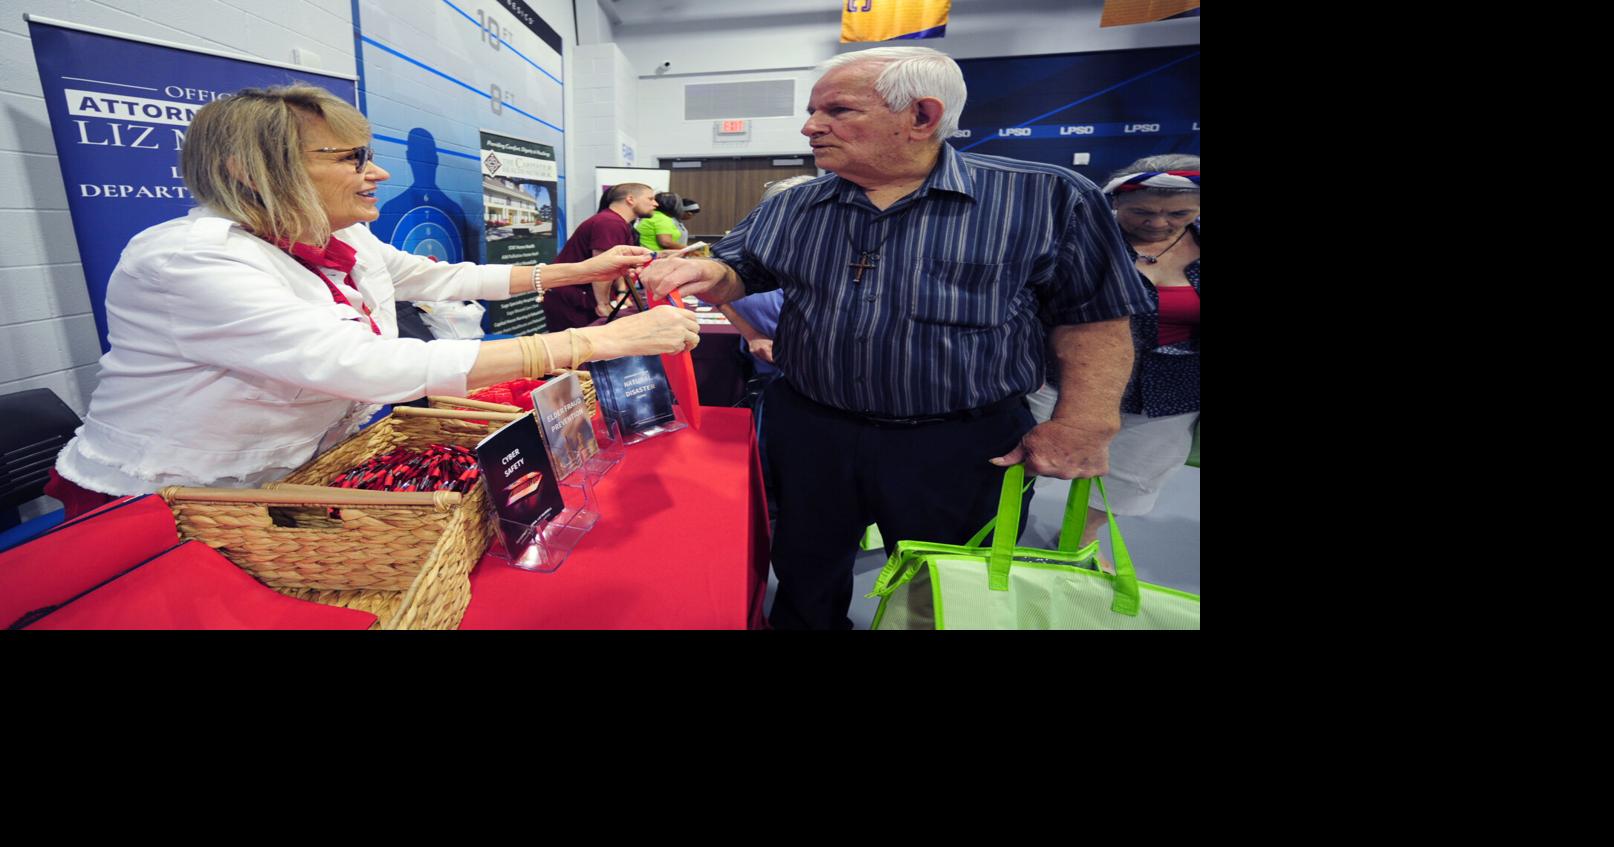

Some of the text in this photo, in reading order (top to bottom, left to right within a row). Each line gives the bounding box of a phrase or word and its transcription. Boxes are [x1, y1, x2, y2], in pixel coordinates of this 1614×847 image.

[477, 9, 500, 51] 10
[165, 85, 233, 101] OFFIC
[491, 84, 501, 116] 8
[79, 96, 197, 122] ATTORN
[72, 120, 160, 149] LIZ
[999, 128, 1031, 136] LPSO
[1060, 126, 1094, 135] LPSO
[1125, 123, 1160, 133] LPSO
[80, 184, 194, 198] DEPART
[501, 448, 520, 465] CYBER
[504, 458, 525, 478] SAFETY
